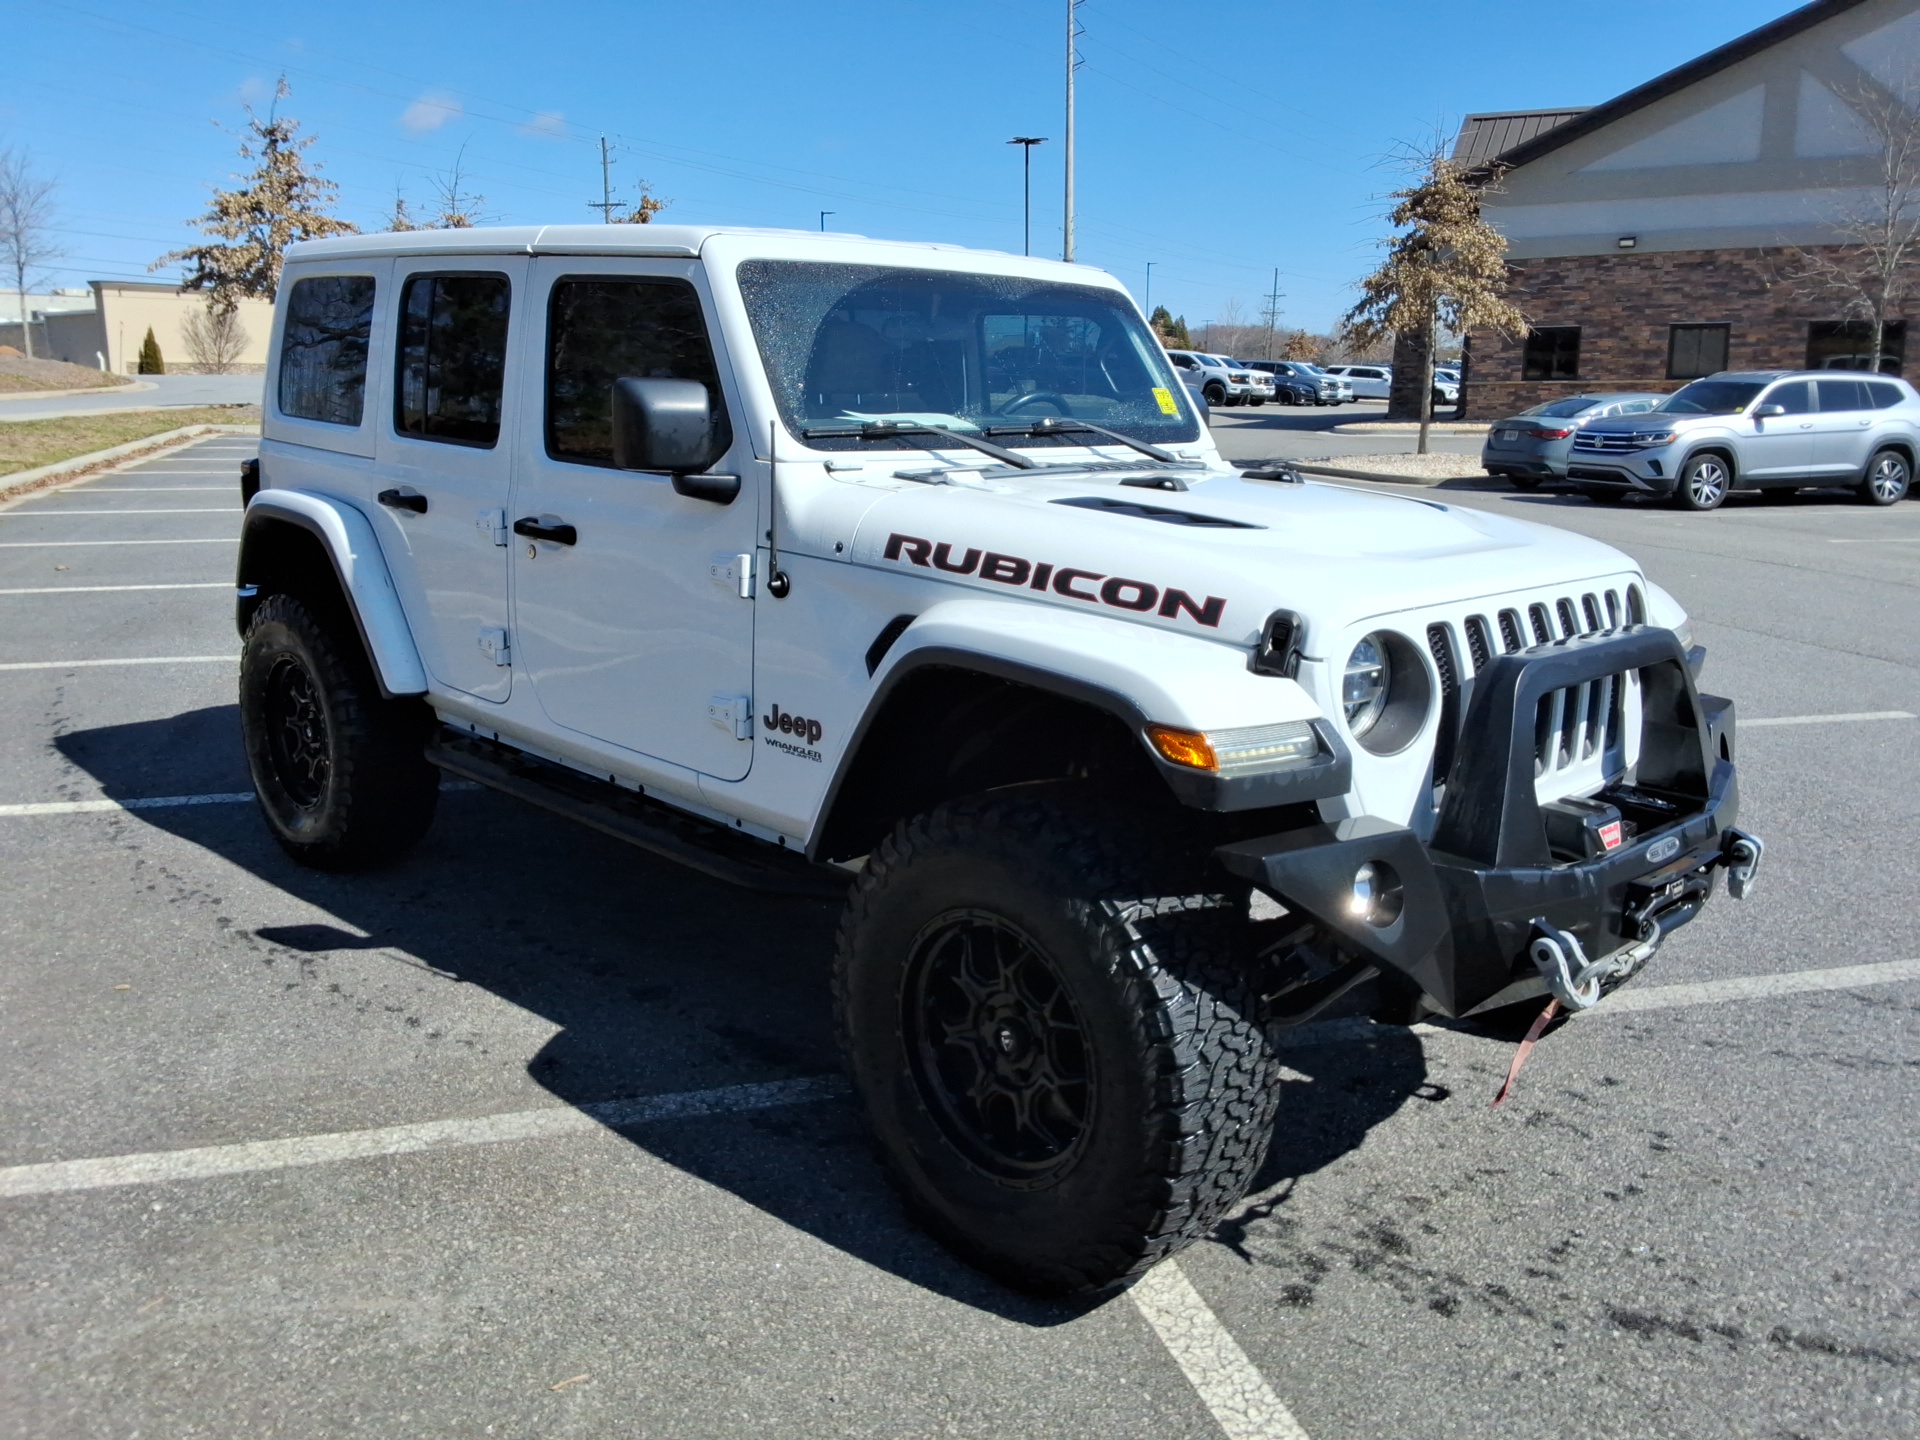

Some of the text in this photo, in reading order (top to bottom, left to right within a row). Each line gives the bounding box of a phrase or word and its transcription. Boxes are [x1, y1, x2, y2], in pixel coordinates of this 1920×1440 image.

[883, 532, 1228, 629] RUBICON
[763, 703, 822, 746] Jeep
[764, 736, 822, 759] WRANGLER
